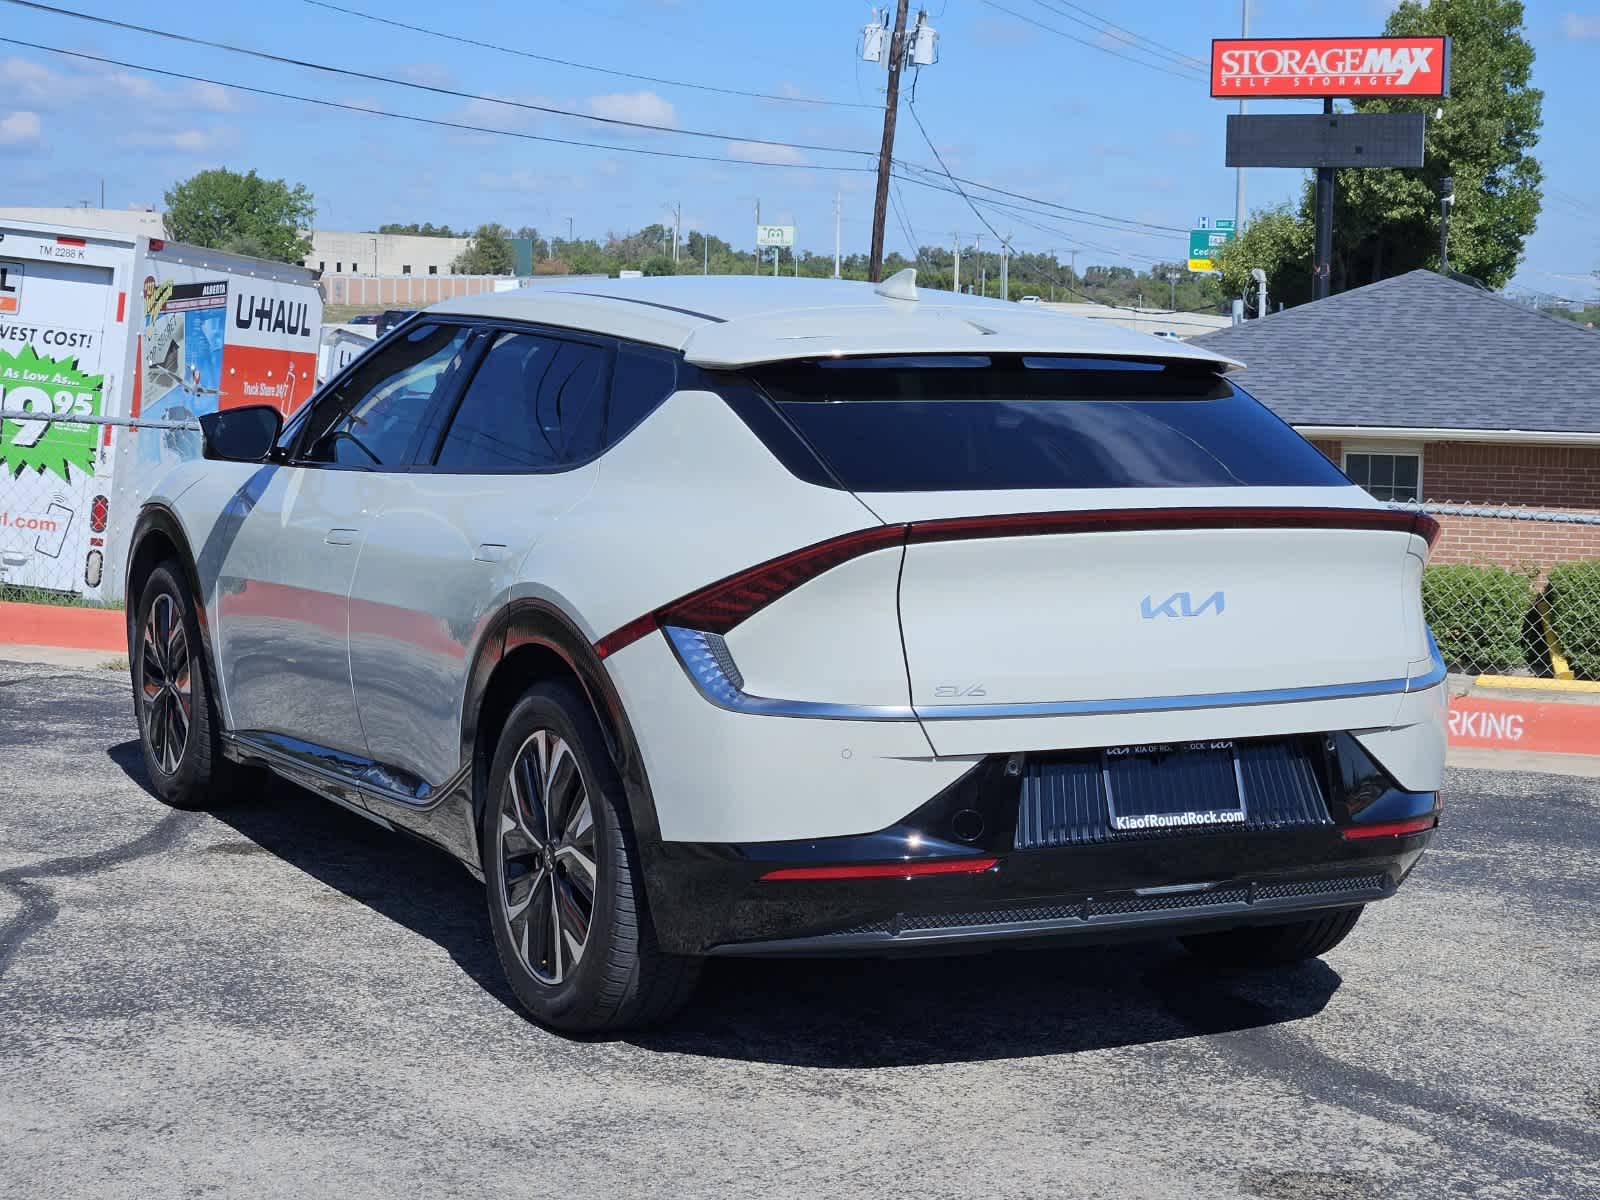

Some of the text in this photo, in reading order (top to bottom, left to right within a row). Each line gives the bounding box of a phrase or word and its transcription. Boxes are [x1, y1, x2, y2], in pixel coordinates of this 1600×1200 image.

[1221, 47, 1434, 85] STORAGEMAX
[1221, 76, 1392, 88] SELF STORAGE
[39, 245, 86, 260] TM 2288 K
[202, 284, 226, 297] ALBERTA
[236, 293, 311, 337] U-HAUL
[43, 329, 93, 349] COST!
[3, 367, 19, 379] As
[23, 368, 49, 382] Low
[243, 381, 260, 395] Truck
[260, 382, 275, 397] Share
[0, 511, 57, 533] l.com
[1141, 591, 1225, 619] KIA
[1116, 810, 1245, 831] KiaofRoundRock.com
